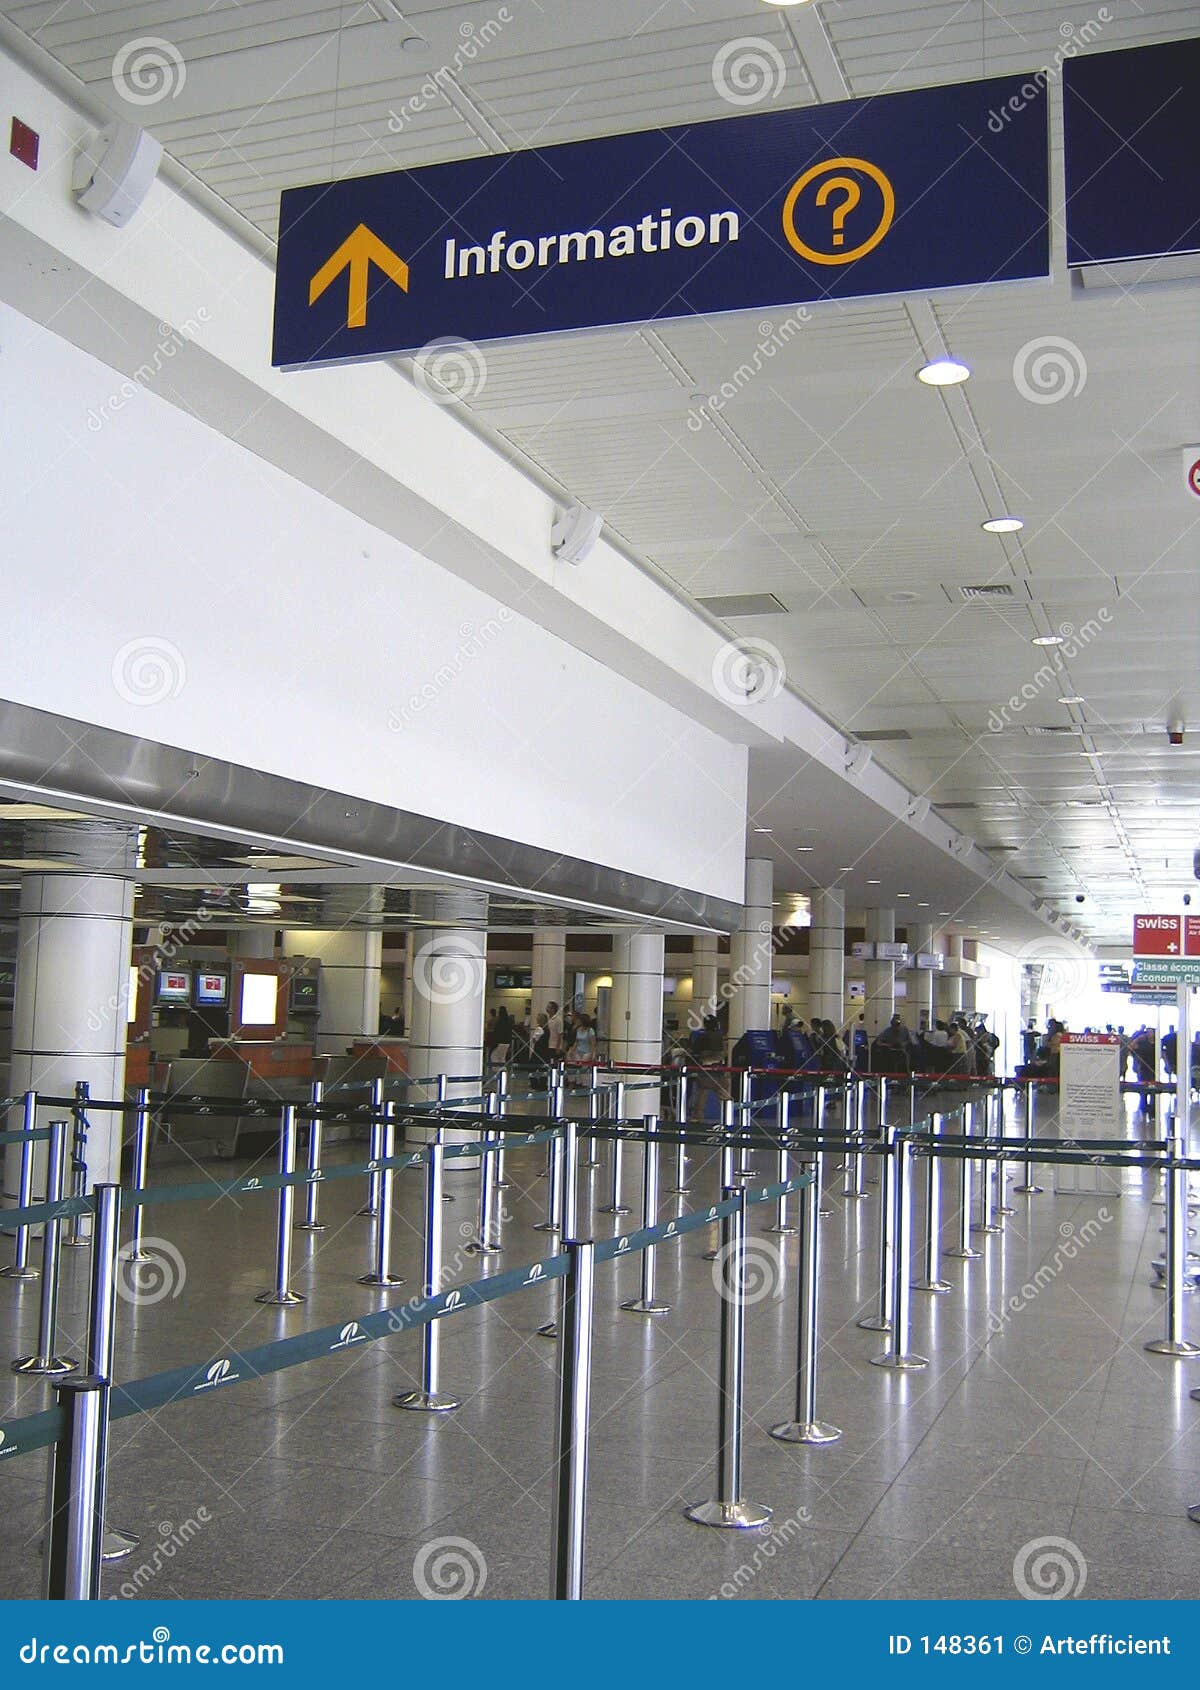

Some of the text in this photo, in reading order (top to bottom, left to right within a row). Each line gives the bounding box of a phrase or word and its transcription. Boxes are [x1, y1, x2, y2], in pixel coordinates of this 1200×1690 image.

[444, 207, 740, 279] Information
[1136, 916, 1178, 930] swiss
[1136, 962, 1168, 972] Classe
[1136, 973, 1181, 983] Economy
[1069, 1034, 1099, 1043] swiss
